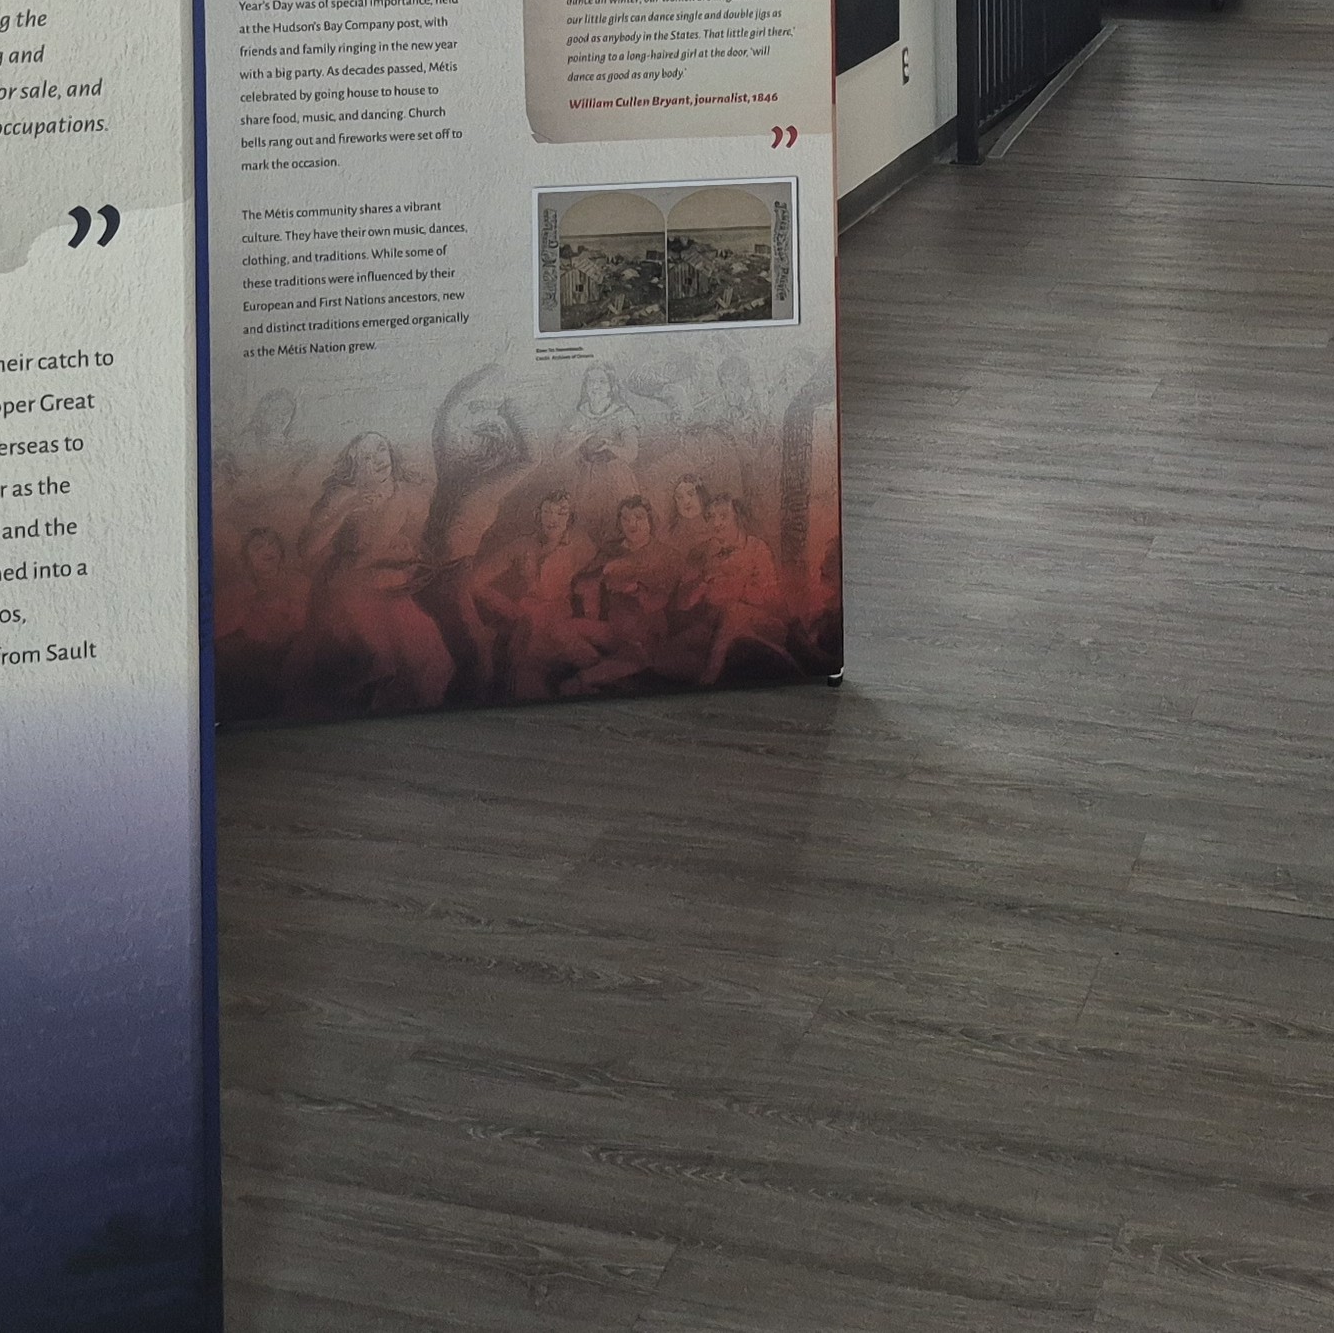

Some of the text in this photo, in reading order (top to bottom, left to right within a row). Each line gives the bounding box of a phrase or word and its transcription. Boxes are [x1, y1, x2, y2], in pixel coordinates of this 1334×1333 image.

[272, 0, 293, 12] Day
[295, 0, 316, 9] was
[239, 67, 263, 79] with
[266, 70, 272, 78] a
[275, 67, 292, 80] big
[326, 65, 339, 76] As
[341, 63, 384, 75] decades
[428, 60, 457, 72] Métis
[569, 97, 613, 109] William
[615, 95, 649, 107] Cullen
[751, 92, 778, 103] 1846
[243, 300, 293, 312] European
[295, 296, 316, 308] and
[319, 296, 341, 307] First
[344, 294, 385, 306] Nations
[442, 291, 464, 300] new
[39, 393, 95, 412] Great
